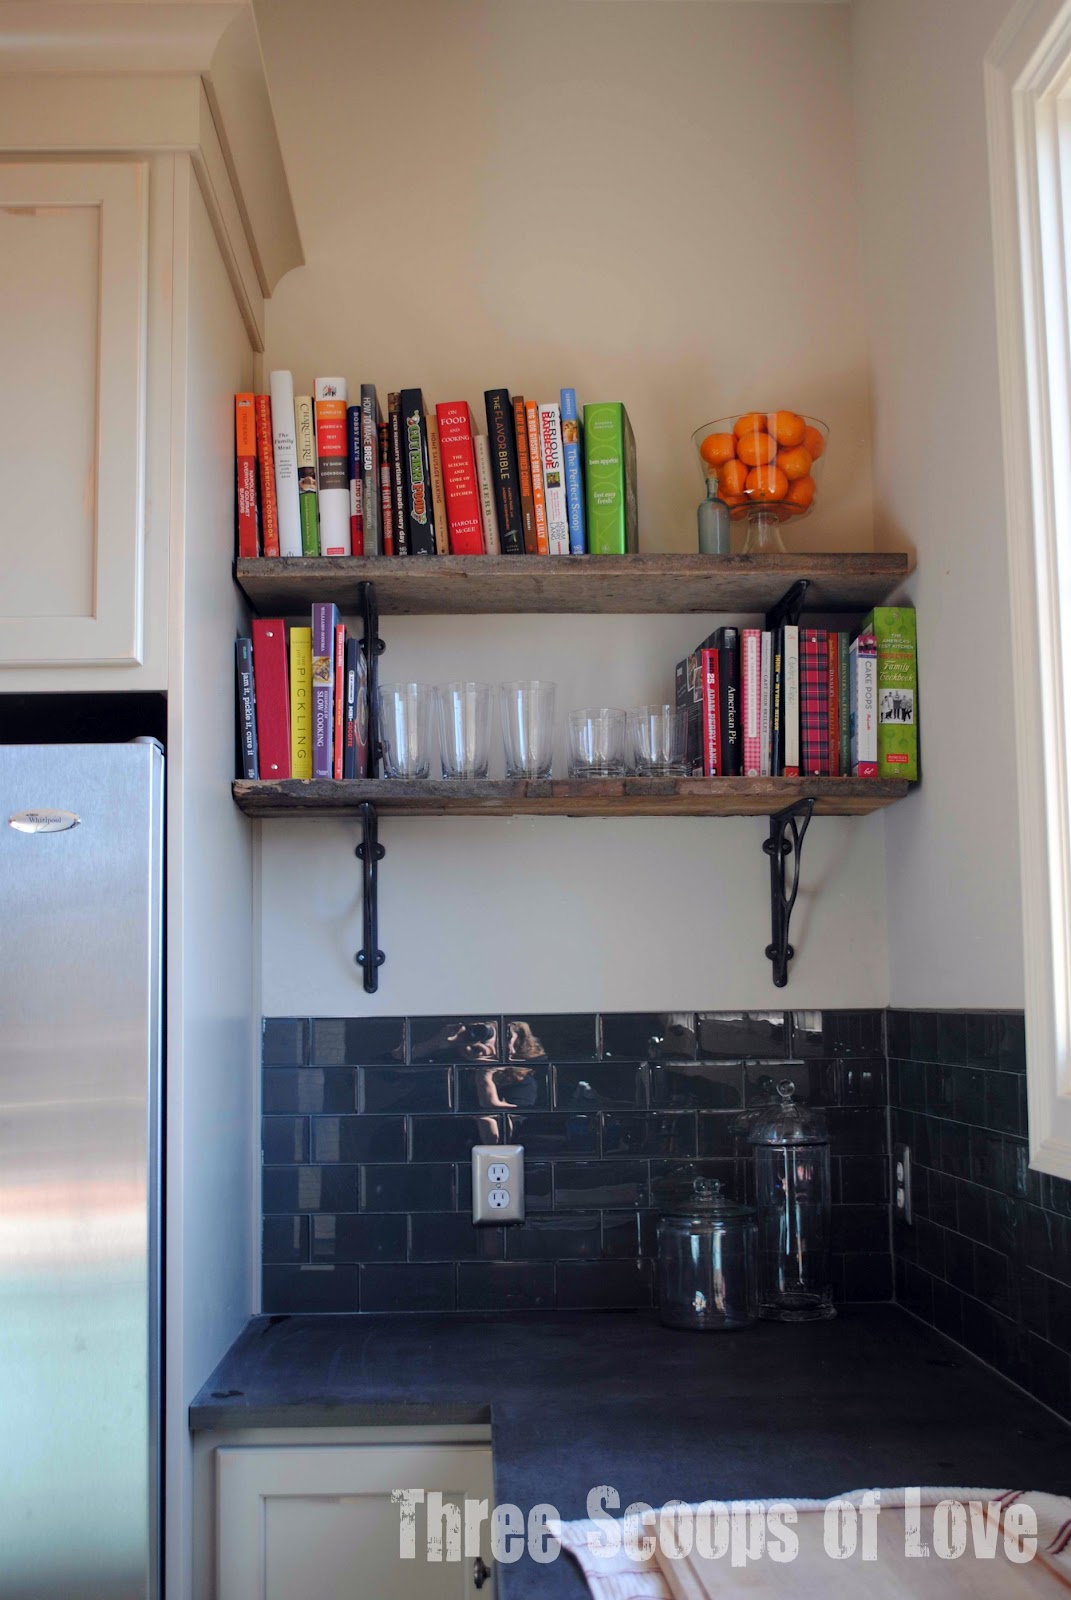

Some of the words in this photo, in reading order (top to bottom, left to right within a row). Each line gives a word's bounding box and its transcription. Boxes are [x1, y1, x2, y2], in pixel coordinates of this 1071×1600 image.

[363, 397, 372, 414] HOW
[515, 402, 523, 413] THE
[364, 414, 372, 424] TO
[440, 416, 466, 425] FOOD
[494, 410, 506, 449] FLAVOR
[516, 414, 524, 425] ART
[528, 420, 536, 432] BOB
[300, 403, 312, 463] CHARCUTERIE
[364, 425, 372, 445] MAKE
[408, 425, 420, 450] GUY
[430, 433, 438, 450] HOME
[442, 435, 470, 443] COOKING
[518, 434, 527, 451] WOOD
[542, 412, 553, 469] BARBECUE
[548, 411, 560, 469] SERIOUS
[530, 433, 539, 460] GIBSON'S
[364, 446, 372, 471] BREAD
[498, 451, 510, 480] BIBLE
[520, 453, 528, 470] FIRED
[568, 450, 577, 466] The
[521, 471, 530, 497] COOKING
[533, 474, 541, 490] BOOK
[570, 469, 579, 501] Perfect
[396, 486, 404, 509] breads
[412, 482, 426, 514] FOOD
[483, 483, 492, 516] HERB
[536, 504, 544, 522] CHRIS
[572, 504, 580, 531] Scoop
[452, 520, 478, 528] HAROLD
[538, 524, 546, 539] LILLY
[880, 672, 914, 682] Cookbook
[884, 660, 910, 673] Family
[243, 697, 251, 720] pickle
[707, 688, 715, 711] ADAM
[728, 686, 736, 728] American
[297, 667, 306, 759] PICKLING
[708, 713, 716, 740] PERRY
[728, 730, 736, 744] Pie
[709, 742, 717, 764] LANG
[29, 816, 62, 824] Whirlpool
